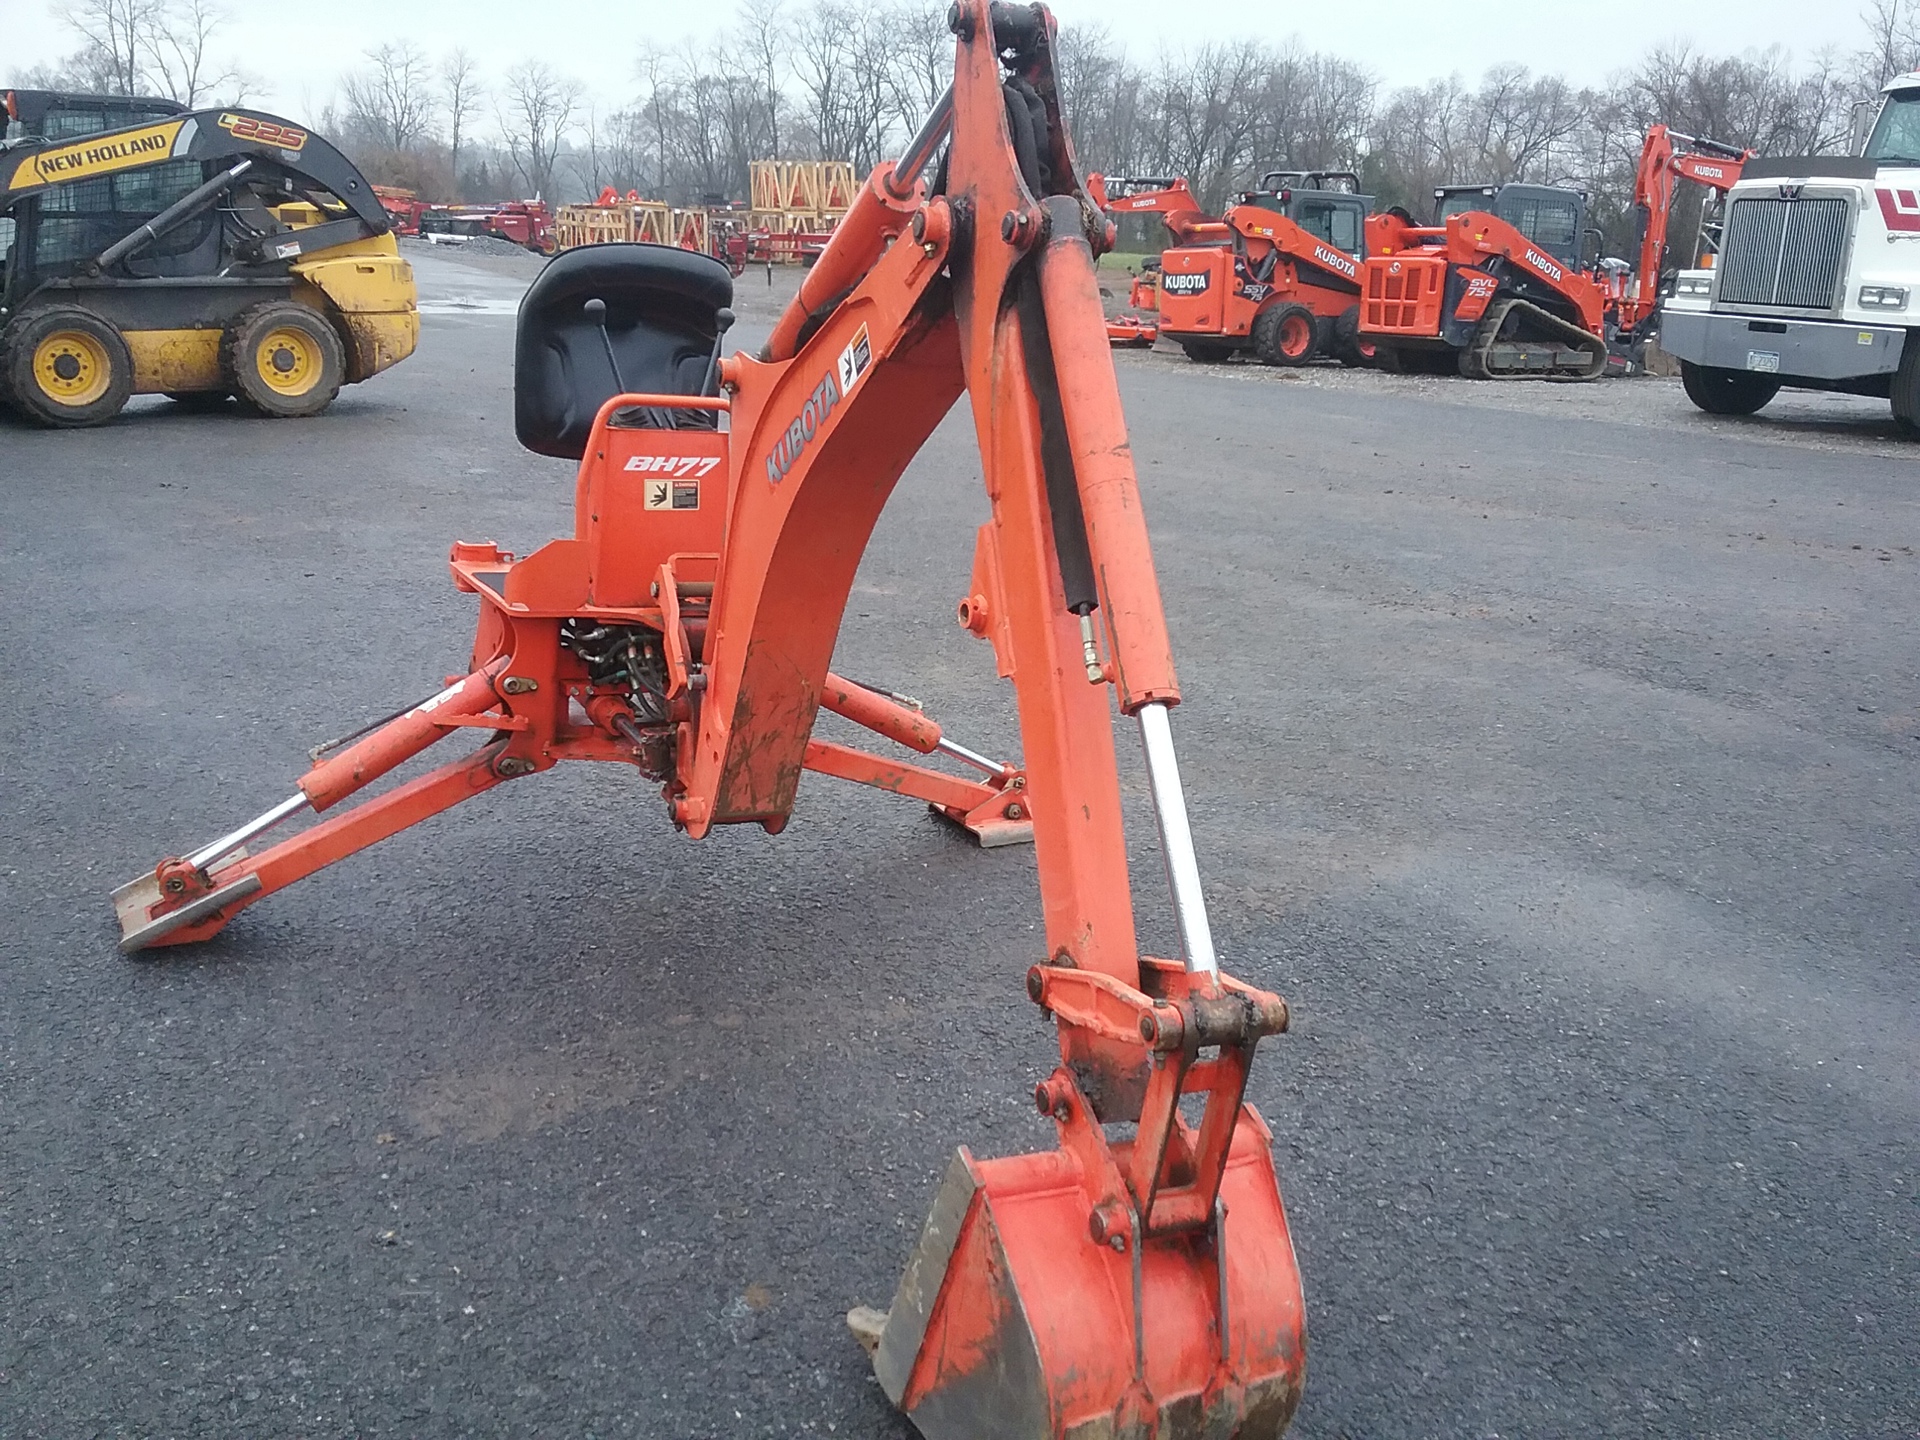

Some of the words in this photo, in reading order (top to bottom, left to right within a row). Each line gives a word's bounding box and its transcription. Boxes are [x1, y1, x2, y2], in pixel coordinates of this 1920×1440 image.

[40, 152, 83, 174] NEW
[85, 134, 167, 164] HOLLAND
[1694, 164, 1723, 179] KUBOTA
[1314, 245, 1355, 277] KUBOTA
[1525, 248, 1562, 282] KUBOTA
[1165, 275, 1206, 289] KUBOTA
[1243, 284, 1269, 294] SSV
[1470, 278, 1497, 288] SVL
[1250, 293, 1263, 301] 75
[765, 370, 840, 484] KUBOTA
[623, 456, 721, 477] BH77
